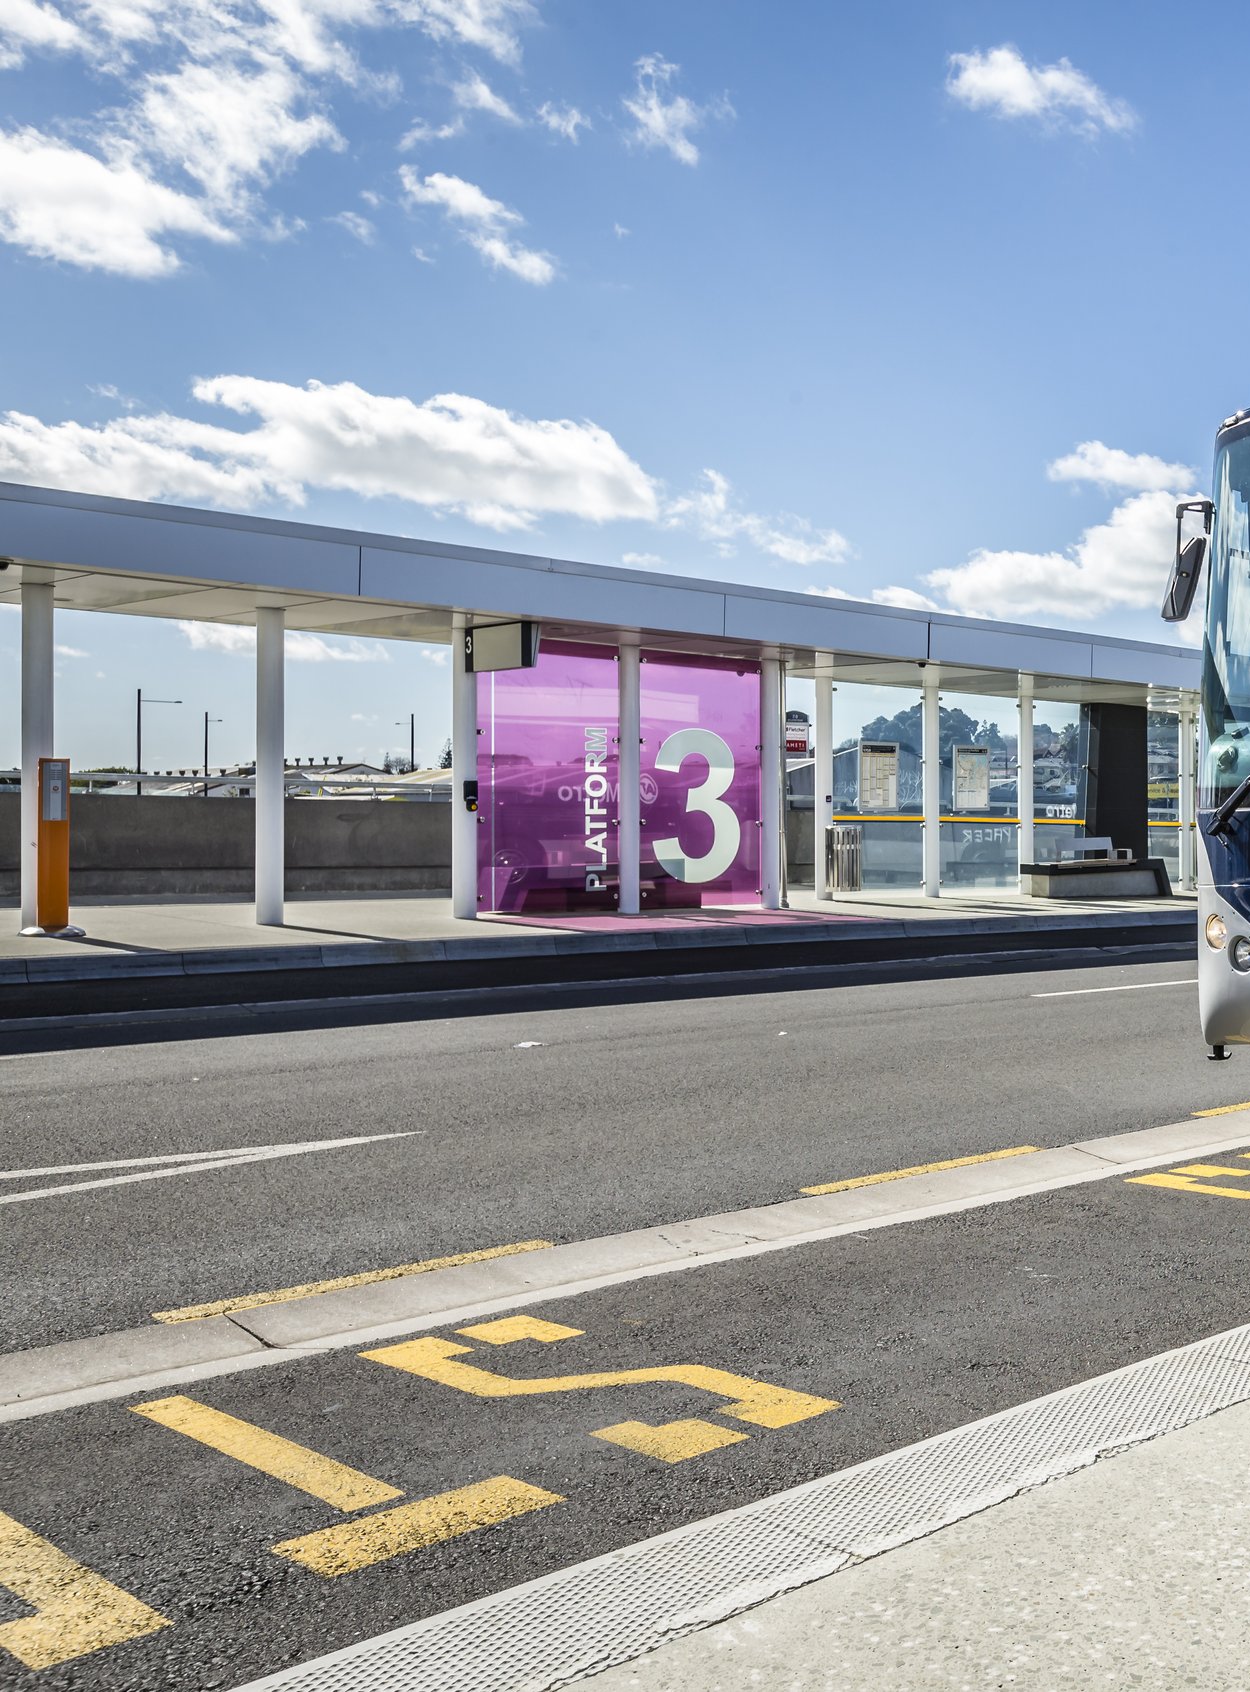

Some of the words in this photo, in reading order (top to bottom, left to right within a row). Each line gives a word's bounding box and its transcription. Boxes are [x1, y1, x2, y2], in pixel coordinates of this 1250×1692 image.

[466, 636, 472, 654] 3
[585, 728, 607, 892] PLATFORM
[653, 728, 741, 884] 3
